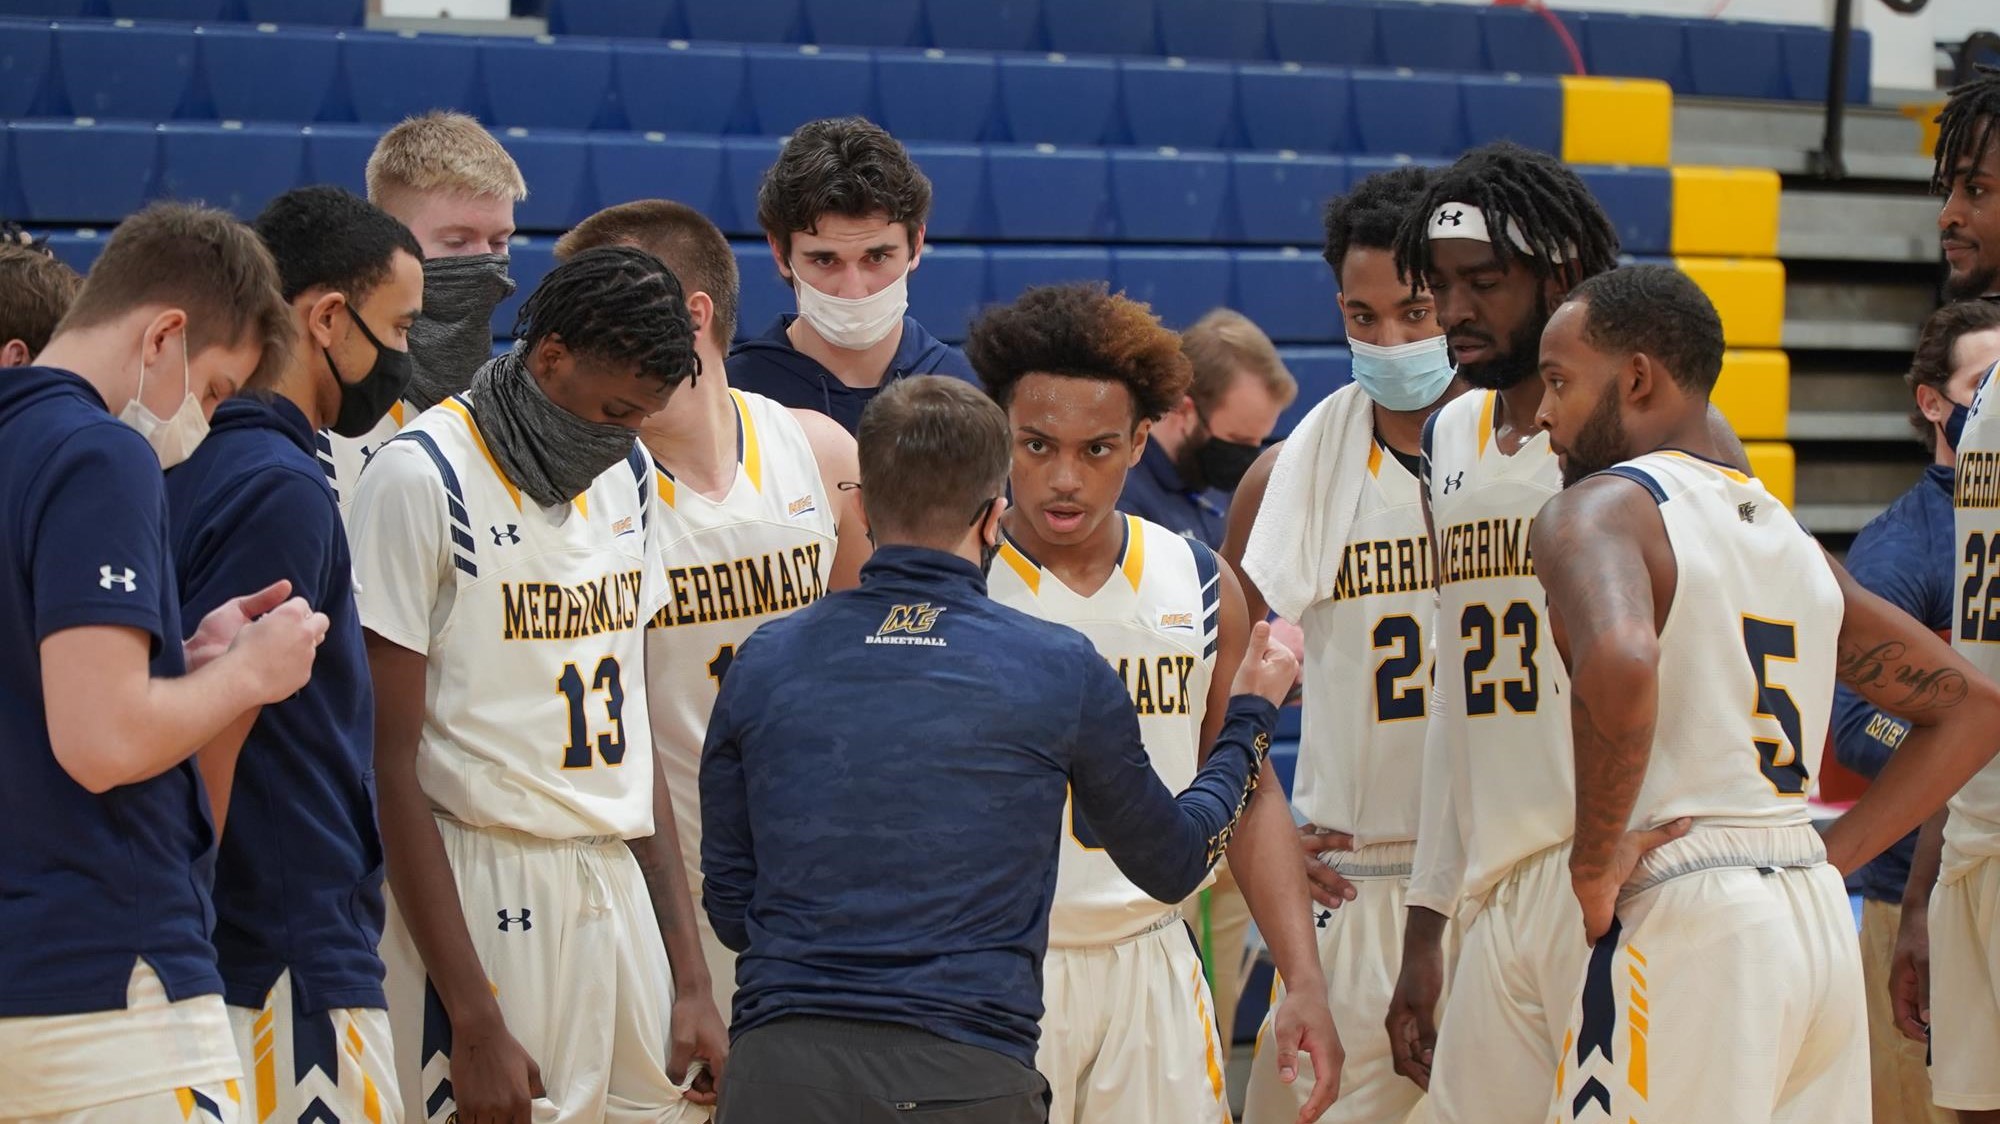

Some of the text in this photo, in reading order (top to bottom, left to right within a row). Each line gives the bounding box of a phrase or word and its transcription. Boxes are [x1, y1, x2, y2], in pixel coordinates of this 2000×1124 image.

[501, 570, 641, 640] MERRIMACK
[1333, 536, 1435, 601] MERRI
[1960, 530, 2000, 643] 22
[865, 636, 947, 647] BASKETBALL
[1161, 612, 1192, 626] NEC
[1460, 599, 1539, 717] 23
[556, 653, 626, 770] 13
[1371, 613, 1435, 724] 2
[1741, 612, 1810, 797] 5
[1865, 713, 1909, 750] ME
